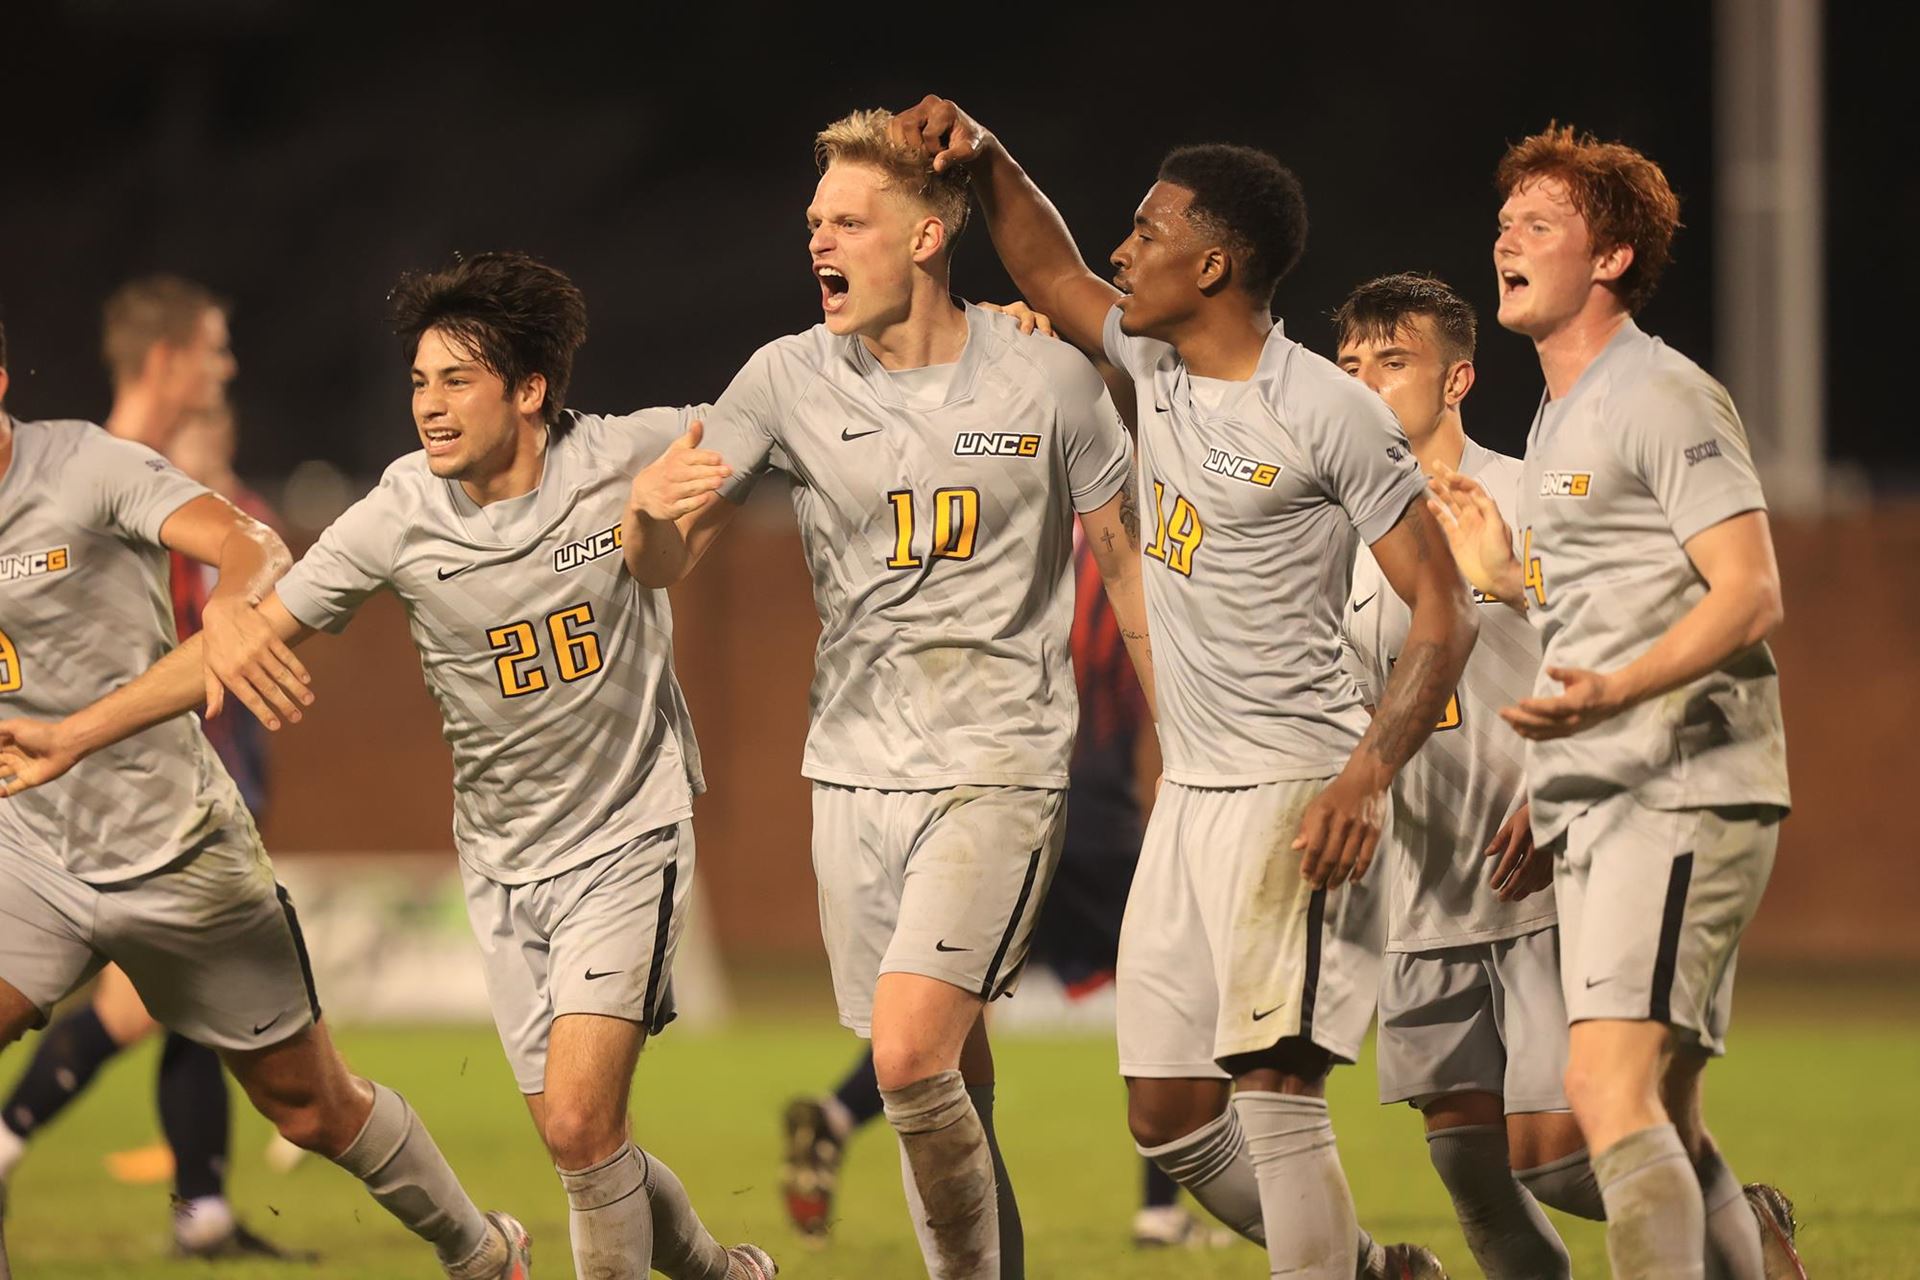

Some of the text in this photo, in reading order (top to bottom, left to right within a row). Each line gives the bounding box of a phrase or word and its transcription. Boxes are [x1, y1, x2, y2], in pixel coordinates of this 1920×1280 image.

[954, 432, 1042, 458] UNCG
[1202, 448, 1281, 488] UNCG
[1541, 472, 1591, 497] UNCG
[886, 486, 981, 570] 10
[1144, 481, 1203, 577] 19
[0, 547, 68, 580] UNCG
[485, 601, 604, 699] 26
